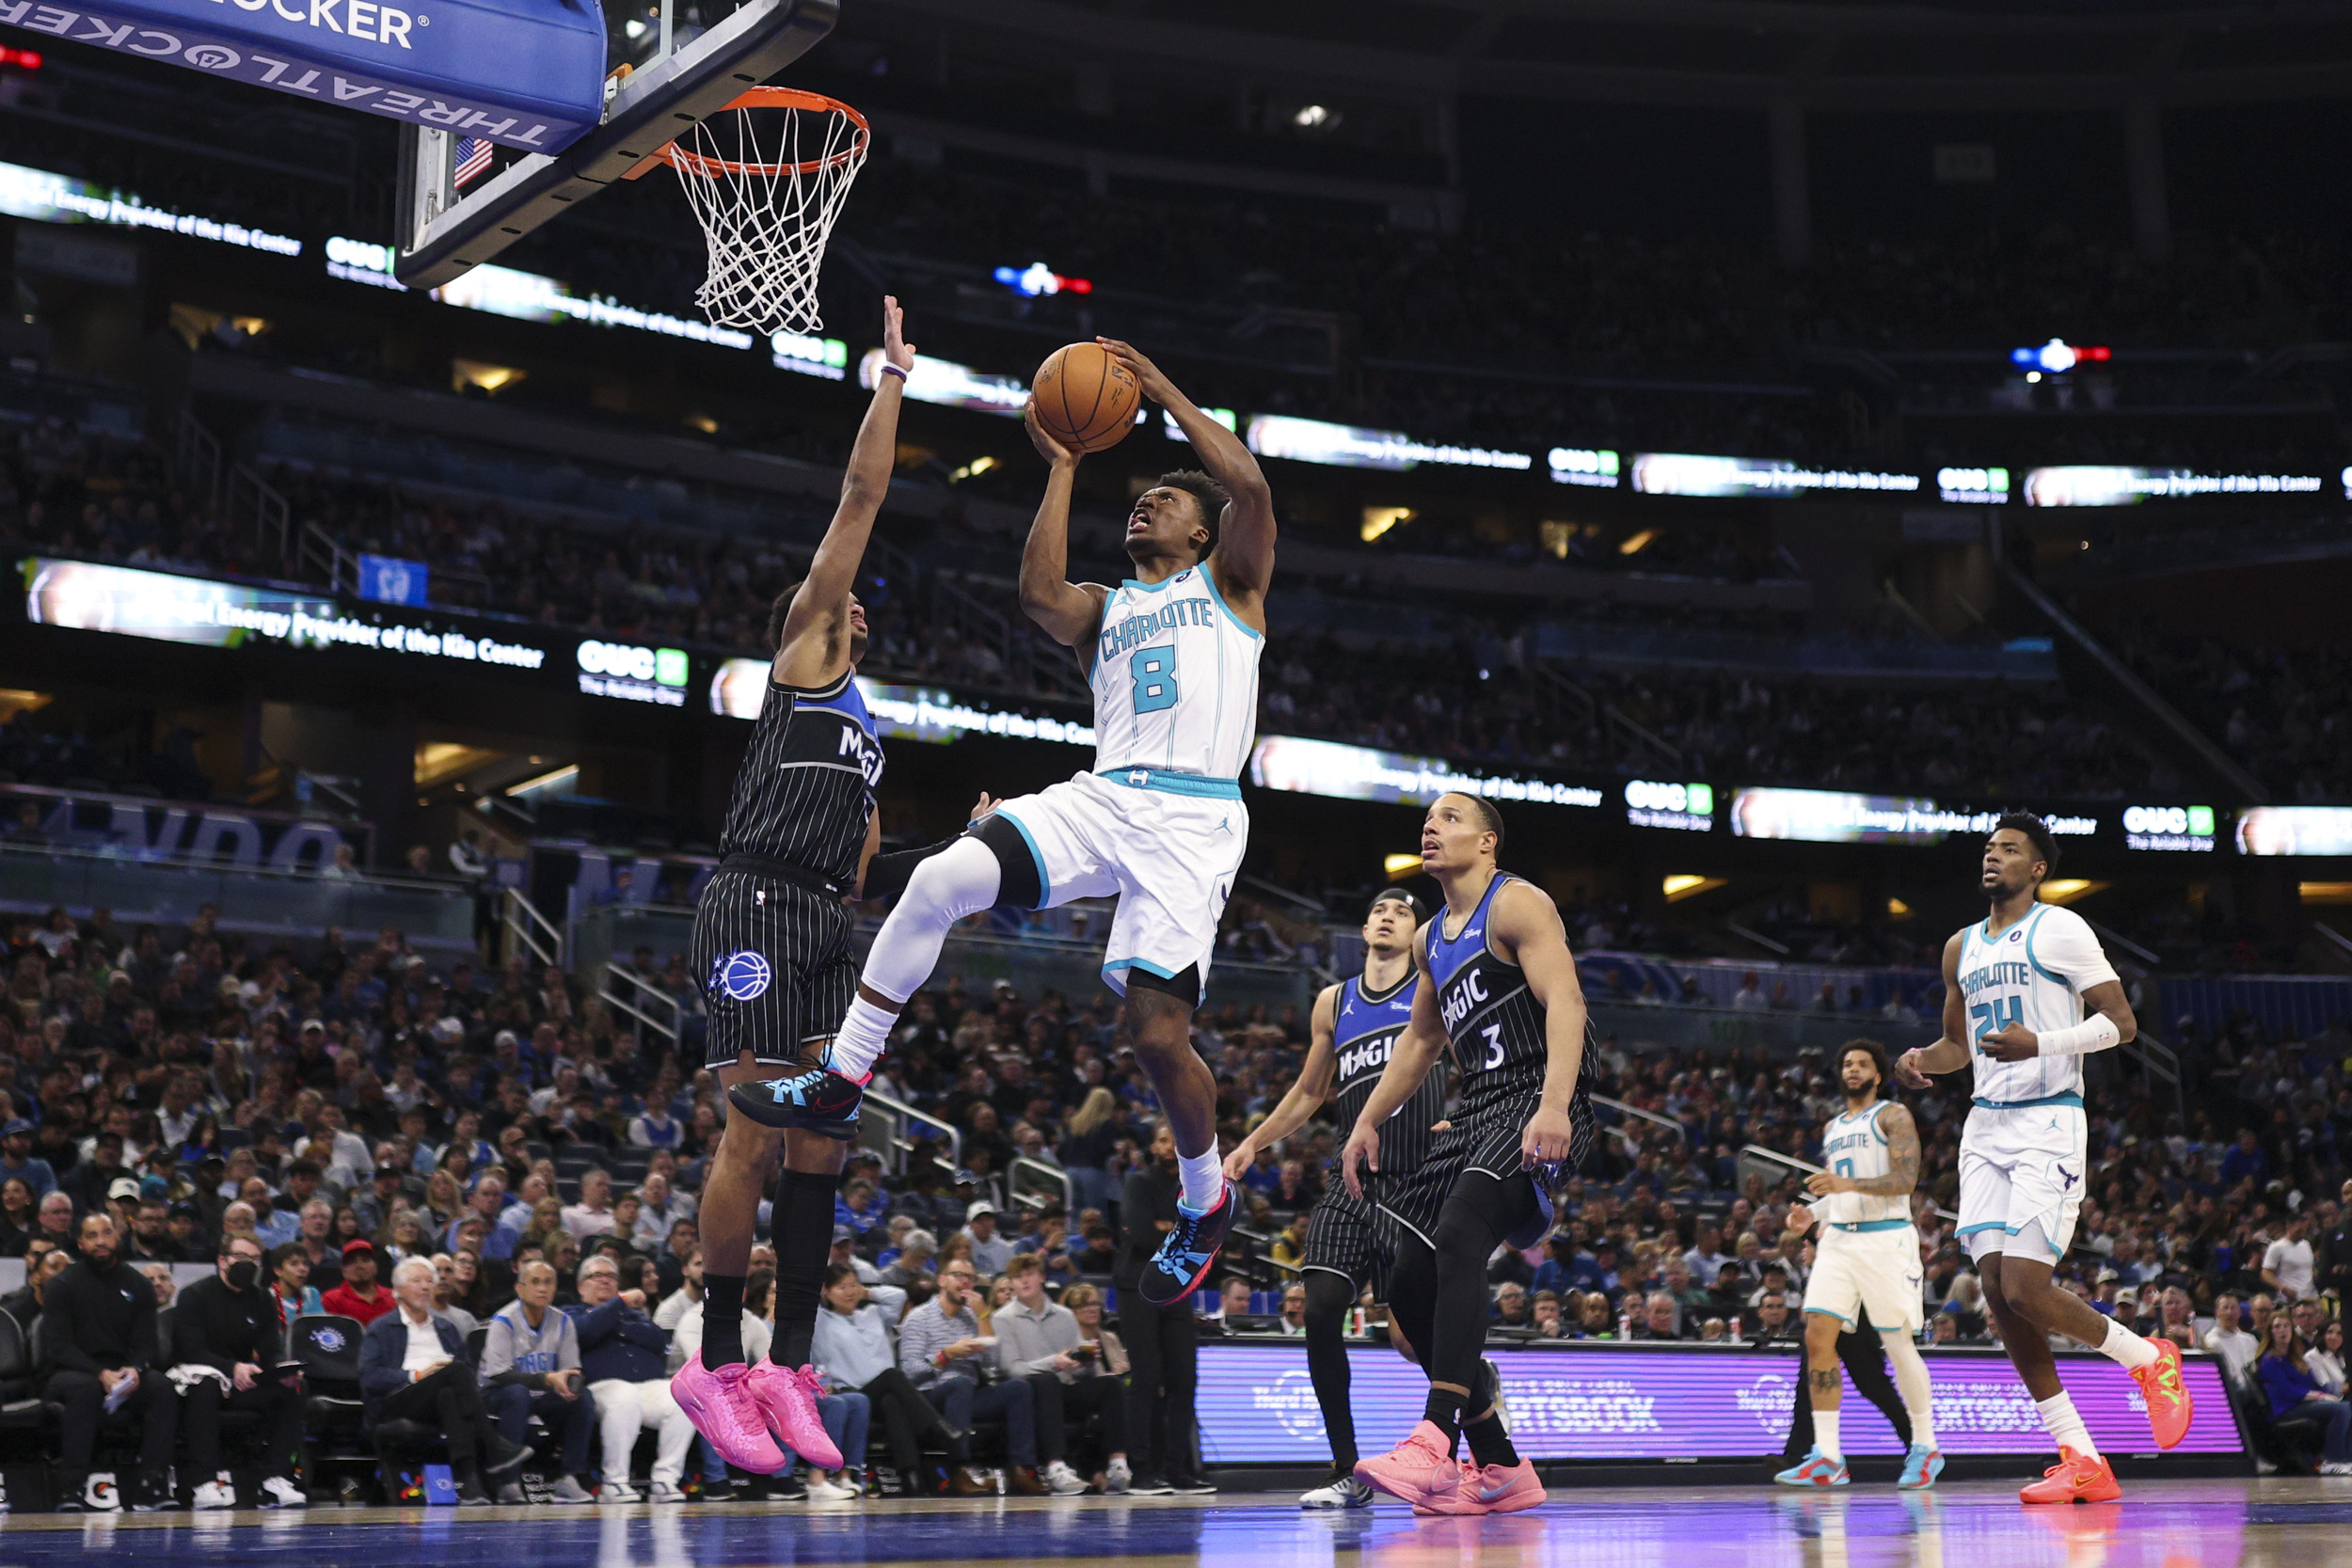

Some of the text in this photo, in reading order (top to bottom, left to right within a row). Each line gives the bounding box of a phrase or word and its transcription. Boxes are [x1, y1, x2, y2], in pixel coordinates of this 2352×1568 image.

[215, 602, 291, 637] Energy
[293, 610, 378, 649] Provider
[381, 626, 404, 651] of
[405, 628, 440, 655] the
[442, 633, 476, 660] Kia
[478, 638, 544, 669] Center
[1100, 597, 1214, 662] CHARLOTTE
[1130, 644, 1178, 715] 8
[988, 712, 1008, 735] of
[1008, 715, 1036, 737] the
[1482, 776, 1500, 799] of
[1500, 778, 1527, 800] the
[1553, 784, 1602, 807] Center
[2123, 806, 2188, 834] OUC
[1481, 1022, 1505, 1070] 3
[1970, 994, 2025, 1056] 24
